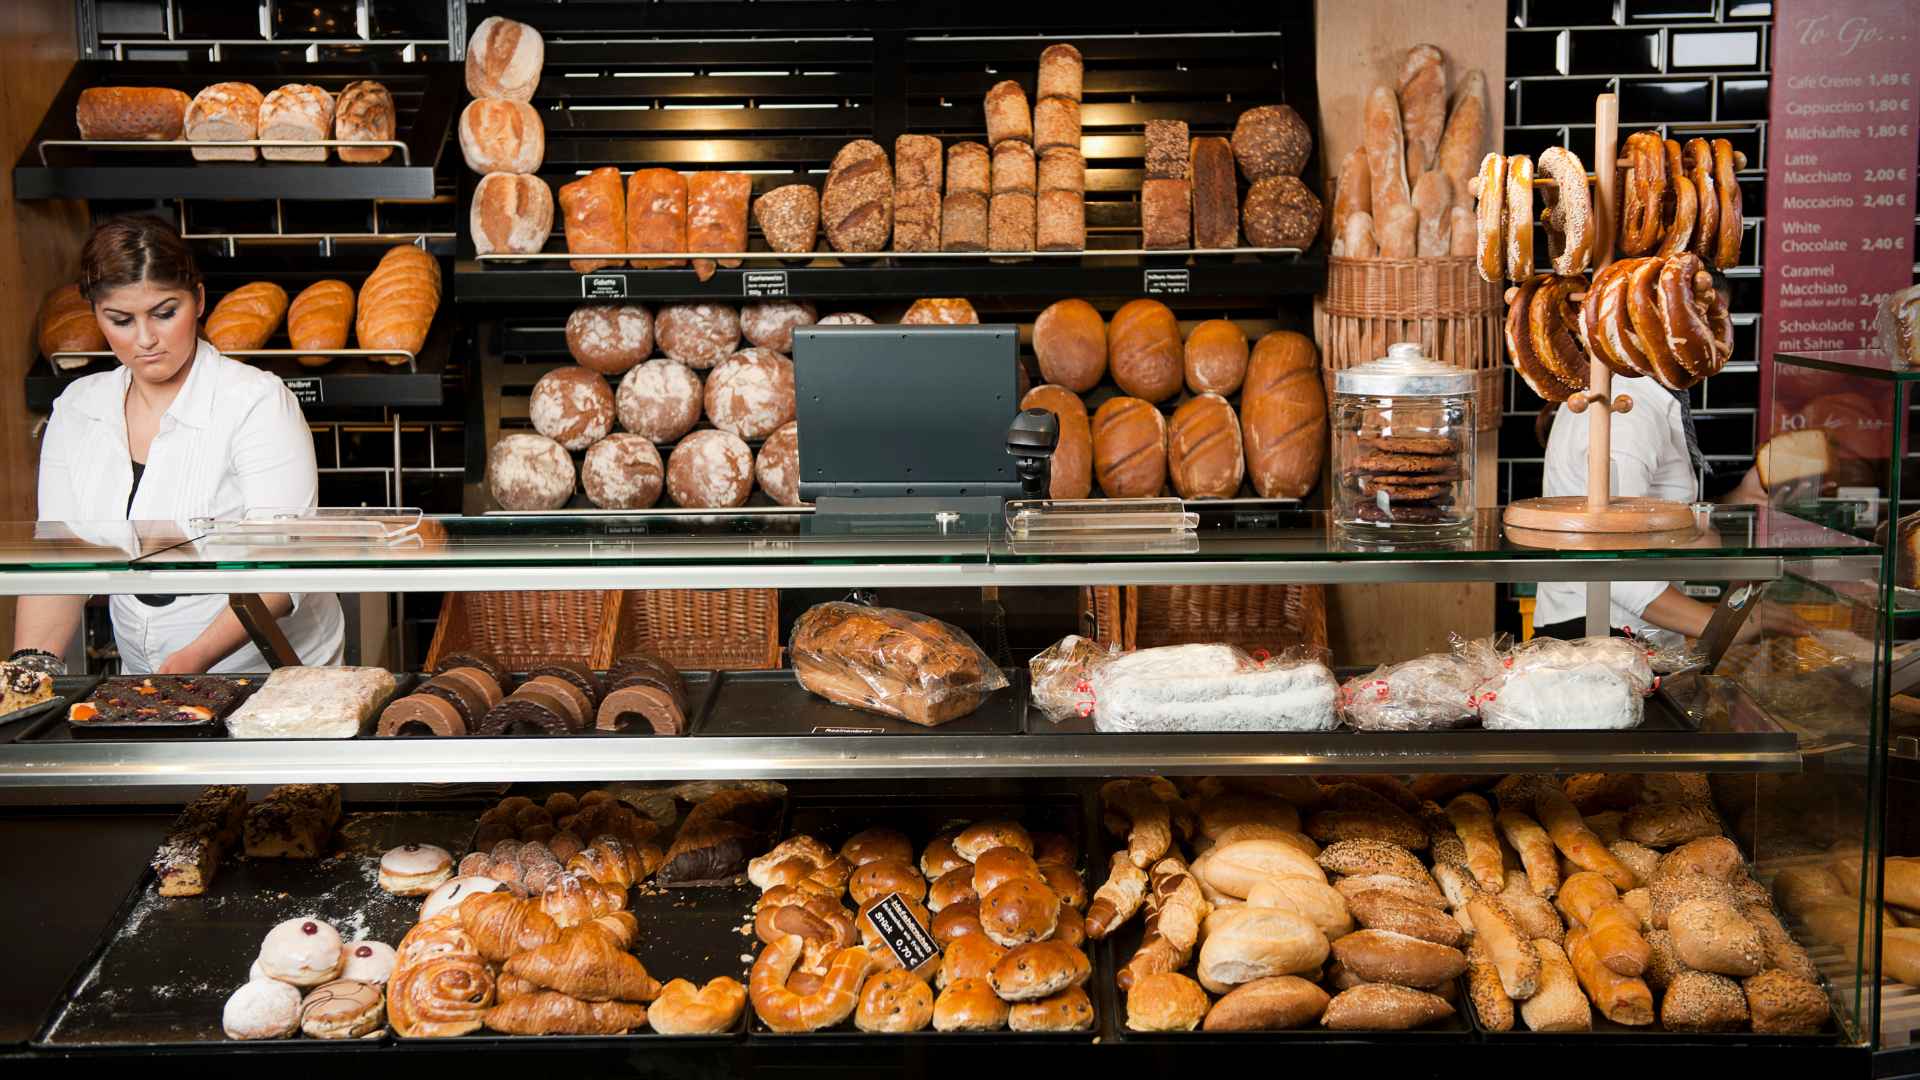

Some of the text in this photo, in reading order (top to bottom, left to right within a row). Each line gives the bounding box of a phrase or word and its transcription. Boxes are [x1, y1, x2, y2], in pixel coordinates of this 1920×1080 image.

[1795, 16, 1827, 45] To
[1868, 73, 1899, 87] 1,49
[1900, 73, 1911, 85] €
[1786, 99, 1910, 116] Cappuccino 1,80 €
[1785, 125, 1908, 139] Milchkaffee 1,80 €
[1784, 153, 1818, 166] Latte
[1784, 168, 1907, 184] Macchiato 2,00 €
[1783, 194, 1906, 209] Moccacino 2,40 €
[1782, 221, 1821, 234] White
[1781, 237, 1904, 253] Chocolate 2,40 €
[1781, 264, 1834, 278] Caramel
[1780, 283, 1848, 296] Macchiato
[1779, 319, 1855, 333] Schokolade
[1779, 338, 1800, 350] mit
[1803, 336, 1844, 349] Sahne
[875, 911, 893, 934] Stück
[909, 957, 918, 966] €
